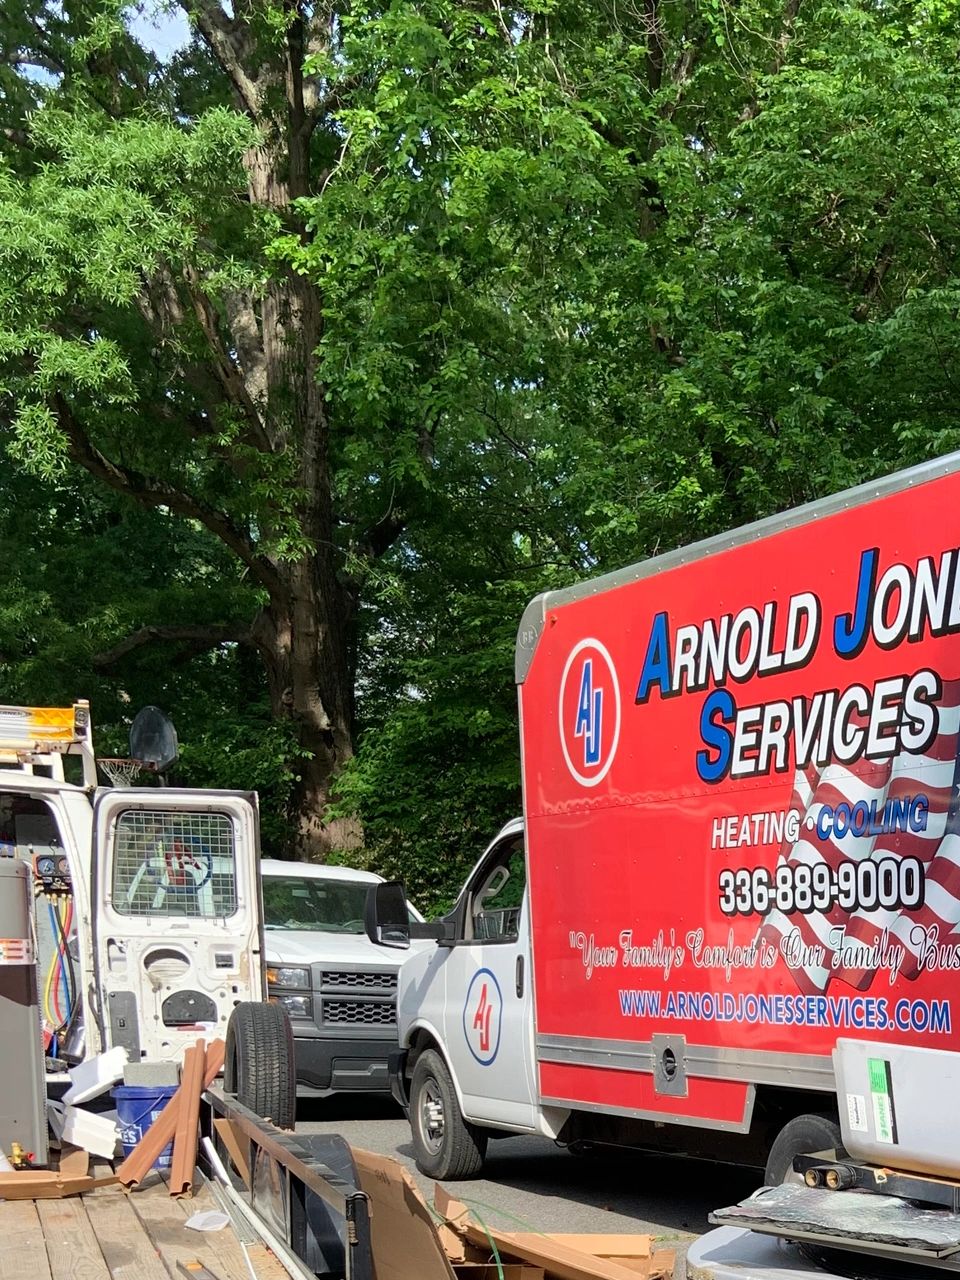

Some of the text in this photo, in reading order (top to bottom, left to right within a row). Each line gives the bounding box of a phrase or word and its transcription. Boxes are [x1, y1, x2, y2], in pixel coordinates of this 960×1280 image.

[636, 591, 821, 704] ARNOLD
[698, 667, 942, 783] SERVICES
[711, 793, 930, 851] HEATING COOLING
[718, 855, 925, 917] 336-889-9000
[619, 928, 685, 981] Family's
[686, 927, 762, 983] Comfort
[759, 937, 778, 968] is
[780, 926, 824, 969] Our
[829, 921, 905, 984] Family
[618, 989, 952, 1034] WWW.ARNOLDJONESSERVICES.COM
